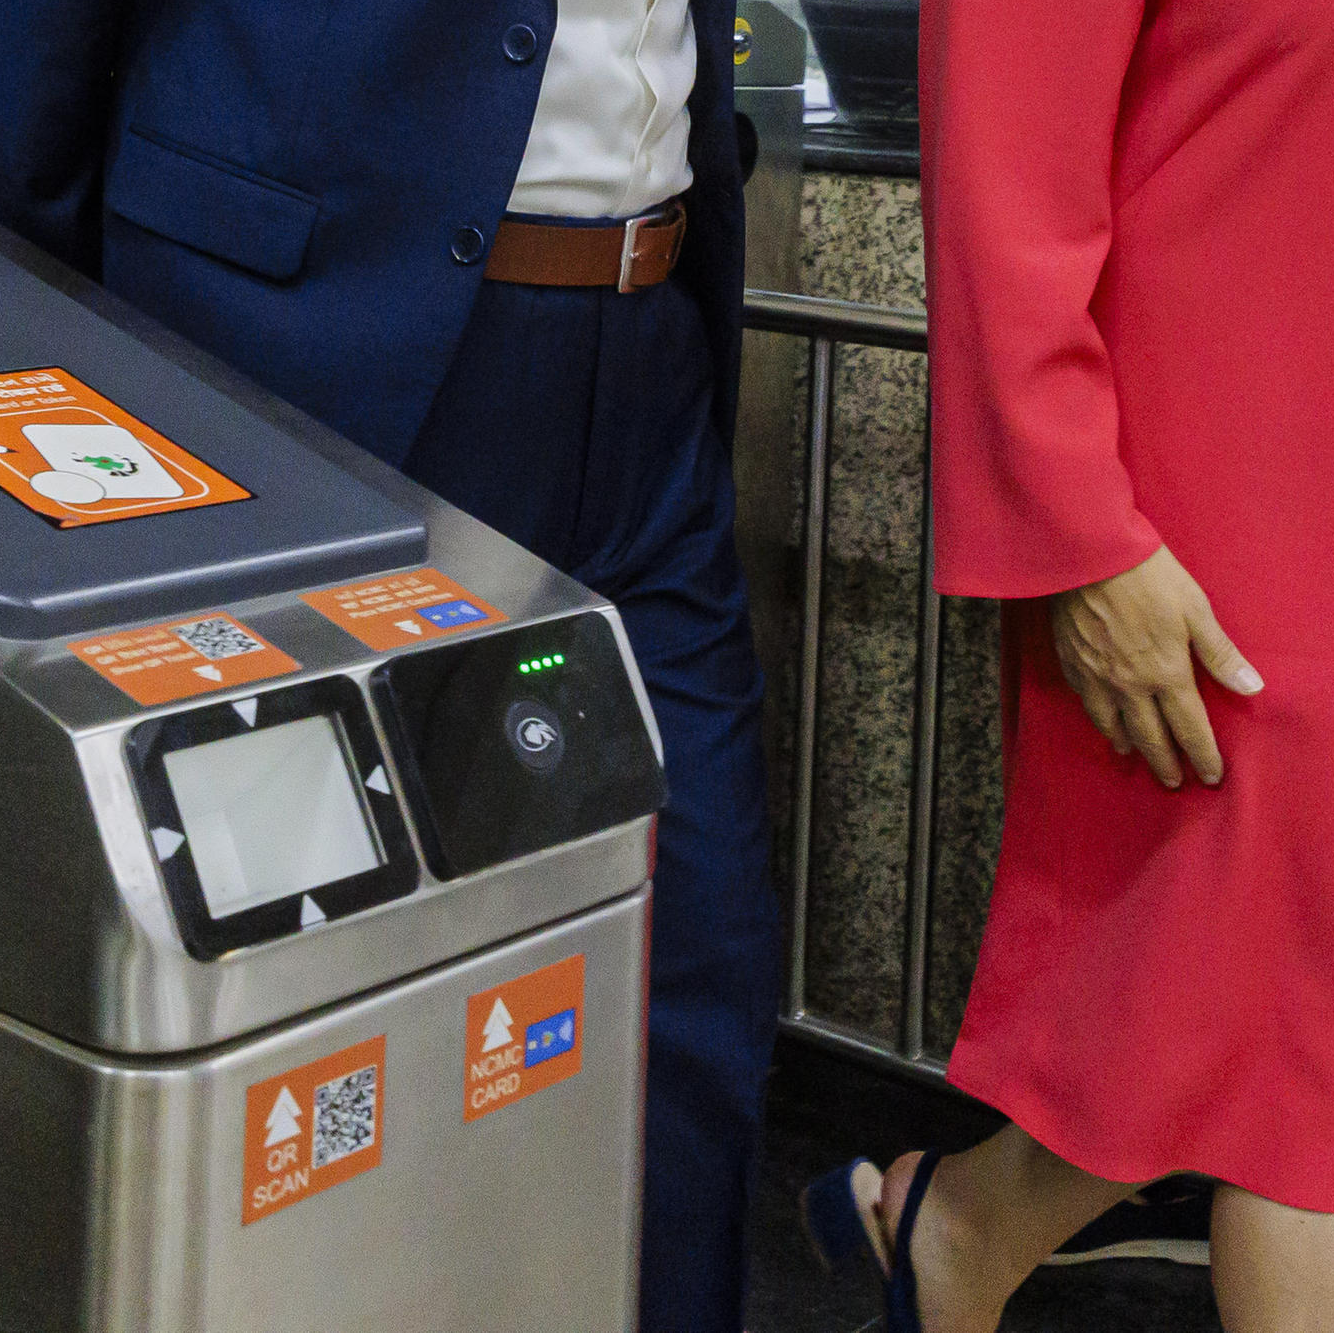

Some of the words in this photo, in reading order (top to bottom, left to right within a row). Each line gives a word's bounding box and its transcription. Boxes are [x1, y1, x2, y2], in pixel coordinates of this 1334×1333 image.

[34, 394, 77, 405] Token
[471, 1044, 523, 1081] NCMC
[470, 1072, 521, 1110] CARD
[267, 1142, 298, 1173] QR
[252, 1168, 310, 1210] SCAN
